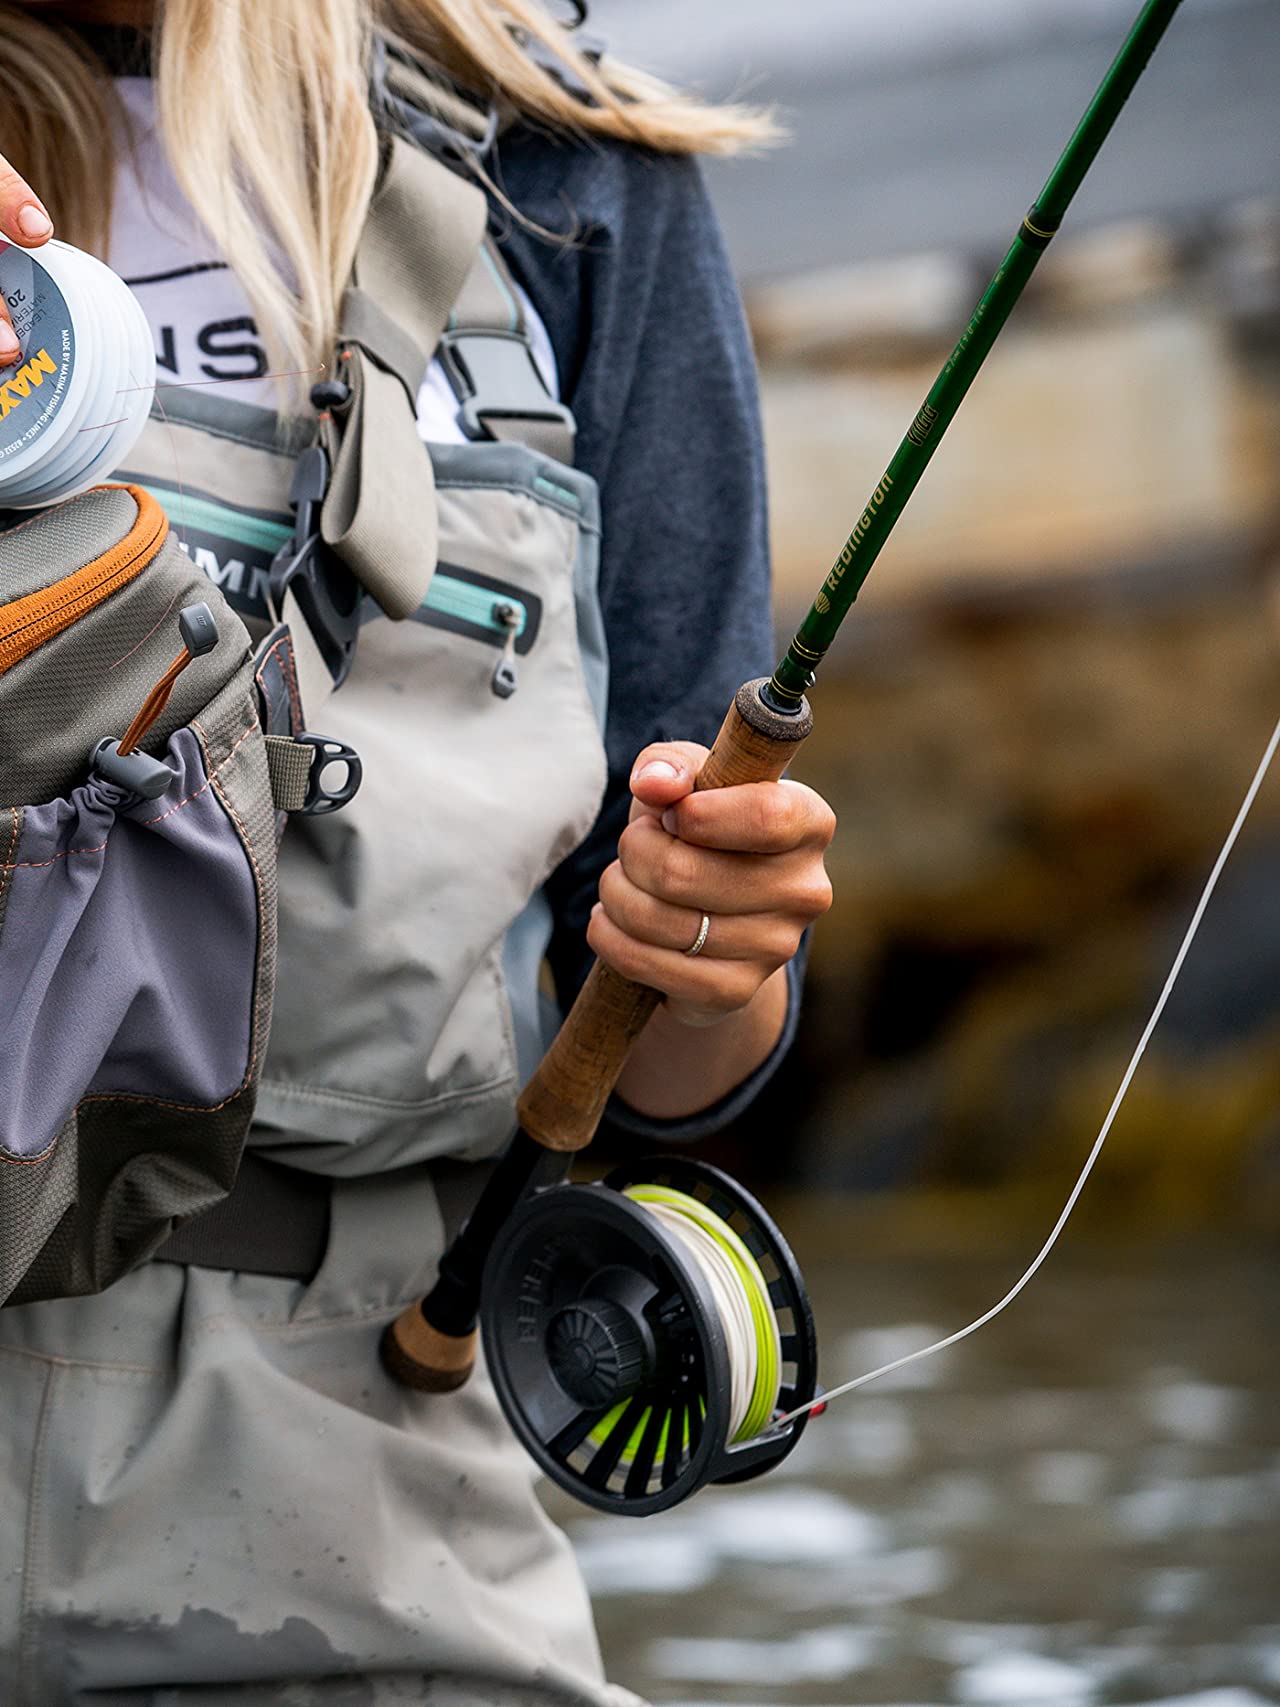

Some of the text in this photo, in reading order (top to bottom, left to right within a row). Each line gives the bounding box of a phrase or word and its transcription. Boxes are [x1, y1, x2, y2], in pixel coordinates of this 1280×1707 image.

[7, 288, 26, 308] 20
[61, 329, 71, 352] MADE
[54, 363, 70, 394] MAXIMA
[39, 393, 61, 423] FISHING
[25, 420, 44, 440] LINES
[826, 472, 895, 592] REDINGTON
